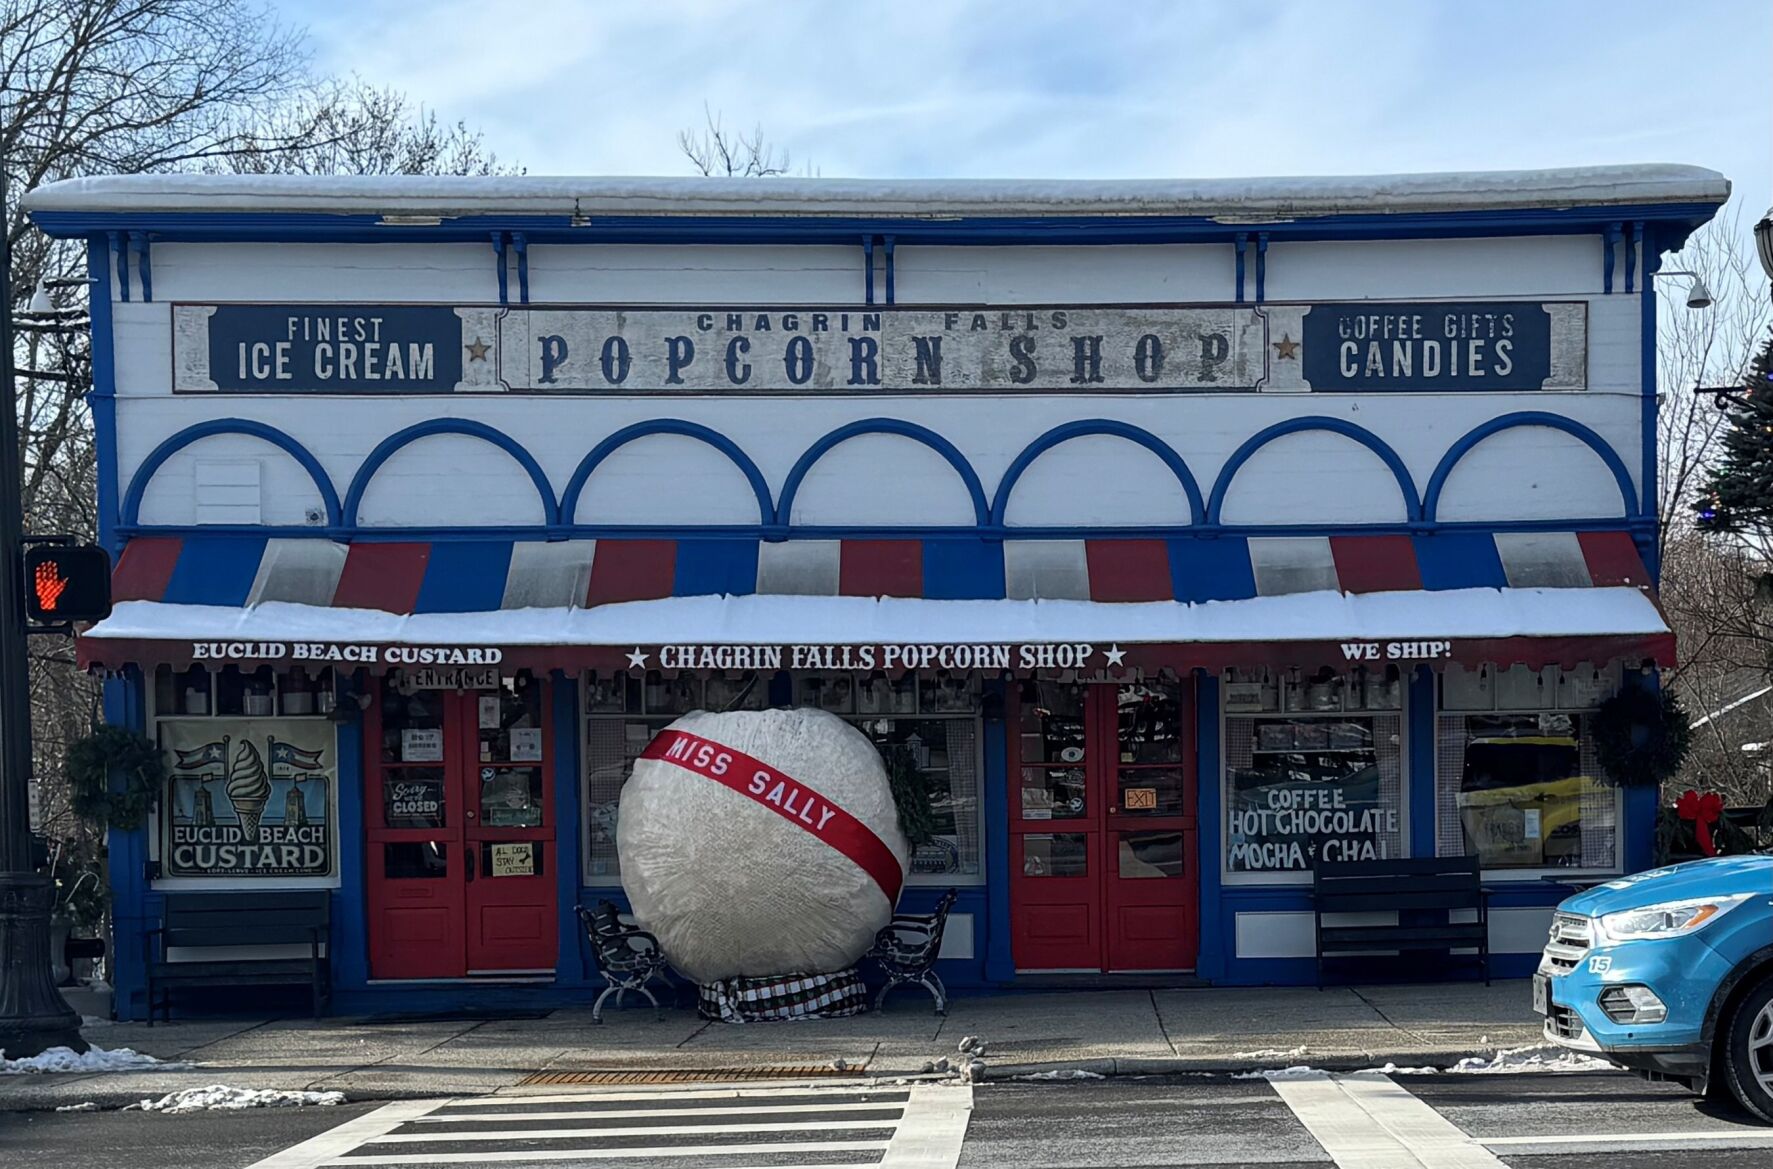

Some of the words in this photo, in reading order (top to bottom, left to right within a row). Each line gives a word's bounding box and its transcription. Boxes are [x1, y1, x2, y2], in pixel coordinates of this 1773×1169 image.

[288, 316, 383, 342] FINEST
[697, 313, 881, 332] CHAGRIN
[945, 312, 1068, 331] FALLS
[1338, 314, 1423, 339] COFFEE
[1443, 313, 1515, 338] GIFTS
[239, 342, 292, 379] ICE
[314, 342, 434, 380] CREAM
[537, 334, 943, 385] POPCORN
[1009, 333, 1230, 384] SHOP
[1340, 339, 1513, 377] CANDIES
[192, 643, 286, 659] EUCLID
[292, 644, 377, 662] BEACH
[384, 647, 502, 664] CUSTARD
[659, 645, 782, 669] CHAGRIN
[791, 645, 875, 670] FALLS
[883, 644, 1011, 669] POPCORN
[1019, 643, 1094, 669] SHOP
[1340, 643, 1380, 660] WE
[1386, 641, 1452, 659] SHIP!
[665, 736, 733, 775] MISS
[748, 771, 836, 831] SALLY
[393, 801, 438, 813] CLOSED
[1127, 790, 1154, 807] EXIT
[1267, 788, 1346, 809] COFFEE
[1229, 809, 1268, 836] HOT
[1275, 809, 1399, 834] CHOCOLATE
[174, 827, 242, 843] EUCLID
[259, 827, 325, 843] BEACH
[174, 845, 325, 868] CUSTARD
[496, 857, 515, 866] STAY
[1229, 841, 1307, 870] MOCHA
[1322, 839, 1388, 862] CHAI
[1590, 957, 1611, 973] 15
